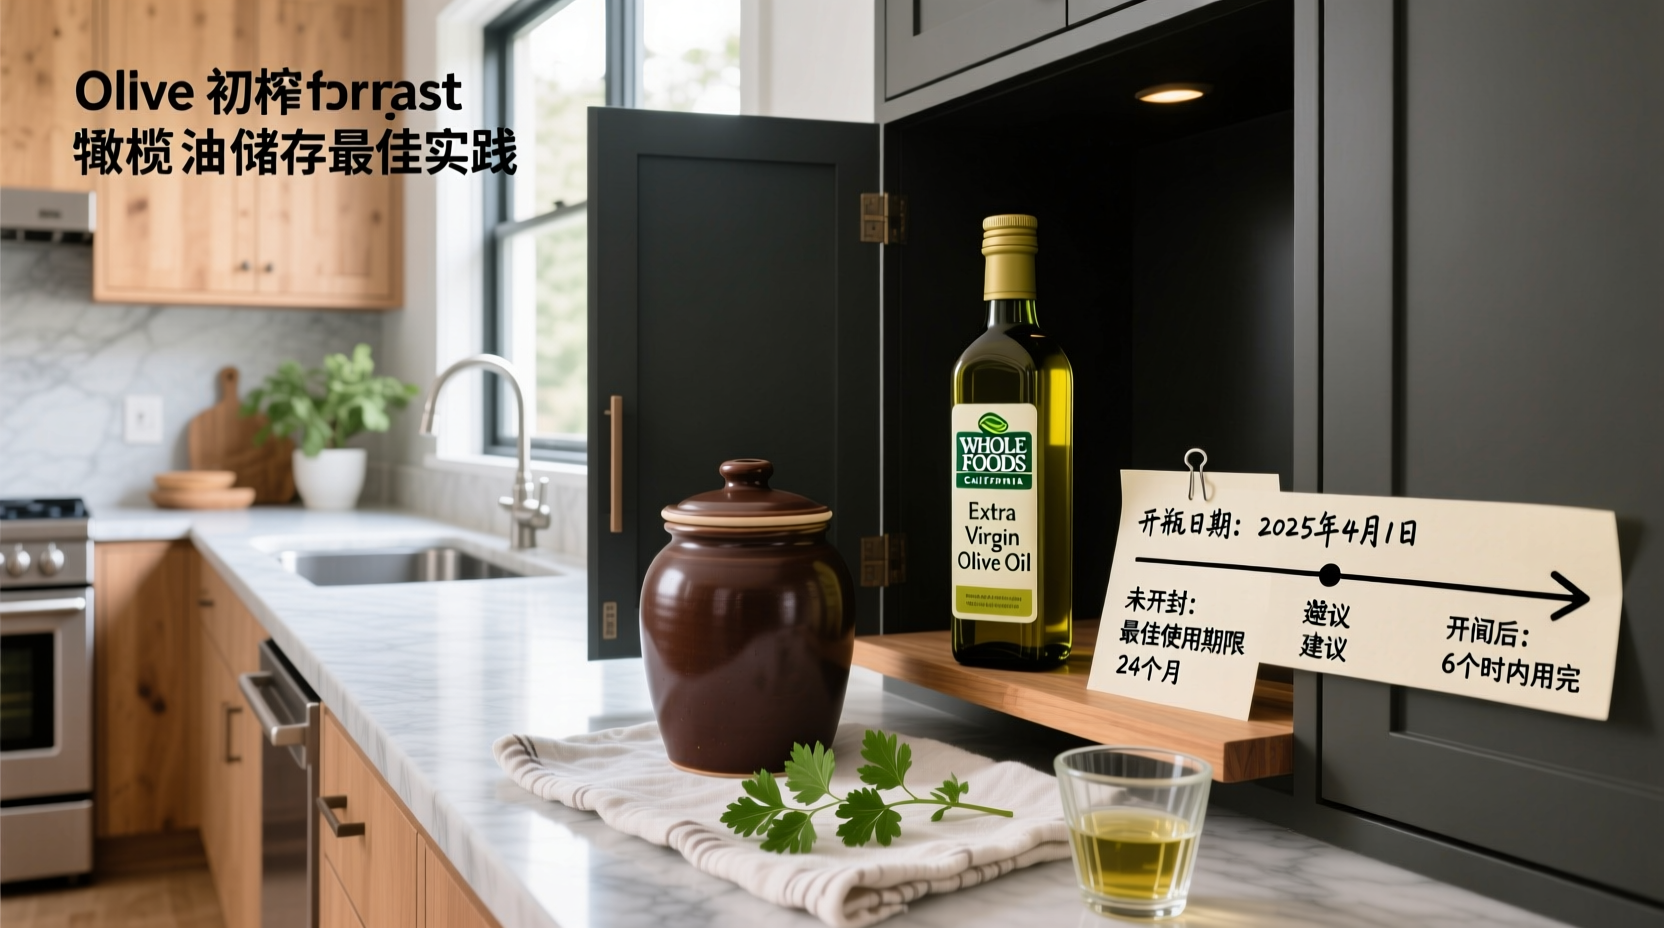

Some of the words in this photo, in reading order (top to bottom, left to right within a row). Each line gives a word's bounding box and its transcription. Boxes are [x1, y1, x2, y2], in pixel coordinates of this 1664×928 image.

[959, 437, 1027, 454] WHOLE
[962, 454, 1026, 472] FOODS
[969, 501, 1016, 521] Extra
[965, 526, 1020, 552] Virgin
[1258, 511, 1417, 549] 2025年4月1日
[958, 551, 1001, 571] Olive
[1005, 552, 1031, 572] Oil
[1119, 619, 1245, 656] 最佳使用期限
[1299, 631, 1348, 663] 建议
[1116, 654, 1181, 685] 24个月
[1441, 652, 1581, 694] 6个时内用完
